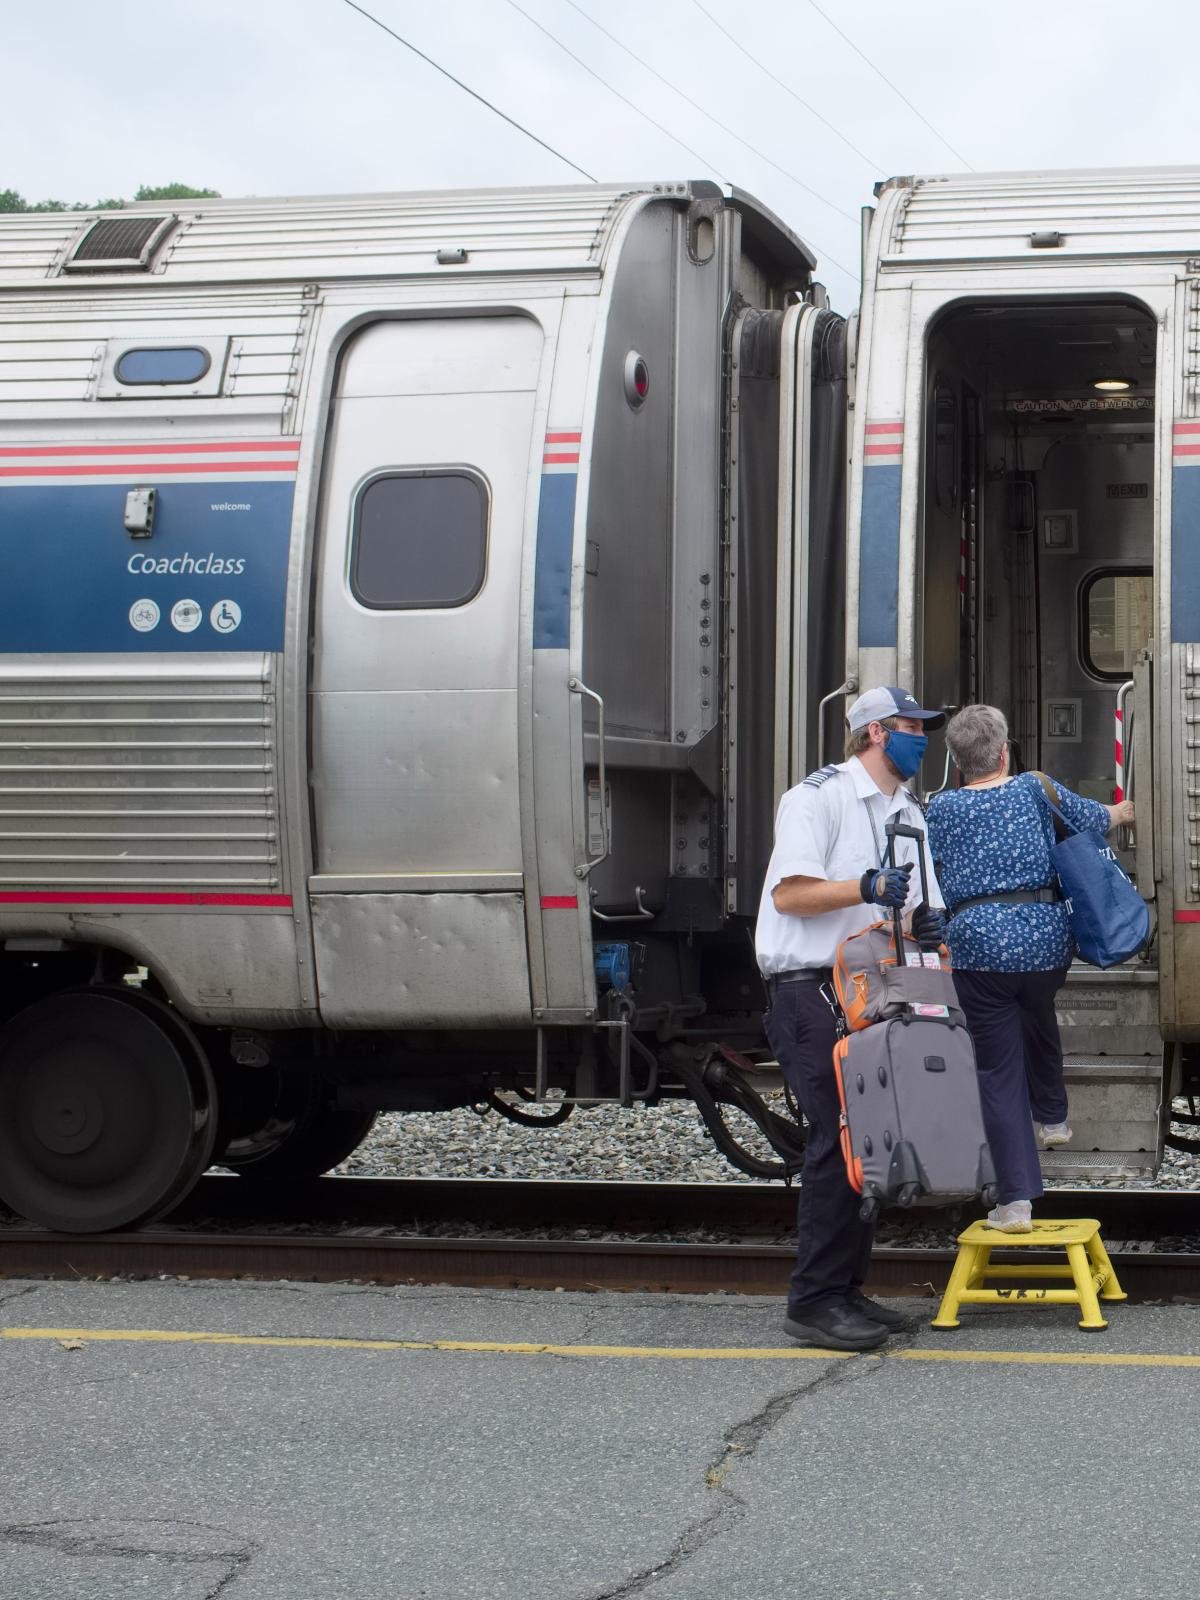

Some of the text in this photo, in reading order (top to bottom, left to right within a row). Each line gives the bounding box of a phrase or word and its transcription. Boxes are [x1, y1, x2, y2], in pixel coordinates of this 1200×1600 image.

[1069, 401, 1087, 409] GAP
[1090, 401, 1133, 409] BETWEEN
[1120, 485, 1145, 496] EXIT
[210, 501, 252, 511] welcome
[127, 552, 246, 574] Coachclass
